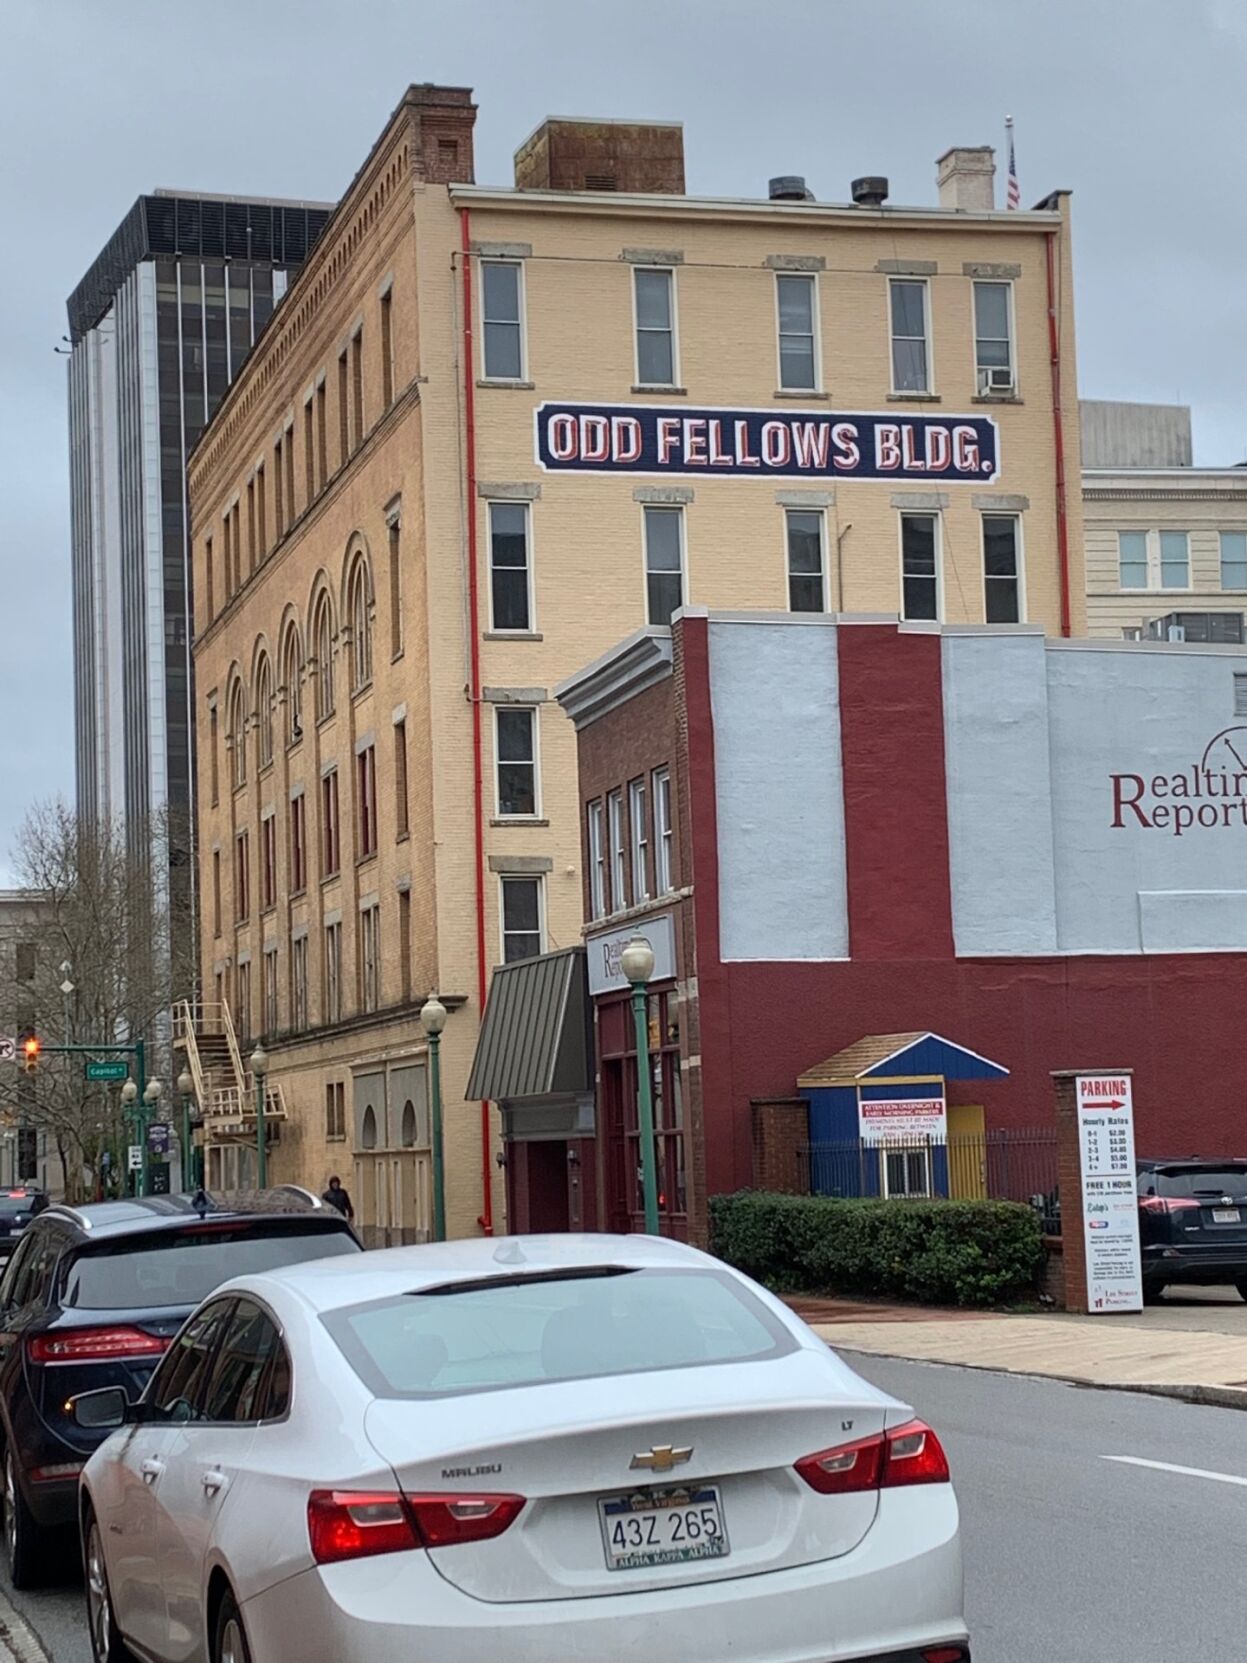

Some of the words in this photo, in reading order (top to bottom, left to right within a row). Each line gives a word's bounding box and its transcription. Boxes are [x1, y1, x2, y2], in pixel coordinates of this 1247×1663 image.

[548, 413, 642, 462] ODD
[656, 417, 860, 470] FELLOWS
[873, 423, 993, 473] BLDG.
[1081, 1080, 1126, 1096] PARKING
[1082, 1117, 1105, 1127] Hourly
[1107, 1116, 1129, 1125] Rates
[1087, 1138, 1098, 1146] 1-2
[1086, 1181, 1104, 1190] FREE
[1107, 1180, 1111, 1190] 1
[1112, 1180, 1132, 1189] HOUR
[841, 1420, 855, 1431] LT
[441, 1463, 502, 1479] MALIBU
[612, 1515, 661, 1549] 43Z
[668, 1508, 718, 1542] 265
[619, 1556, 650, 1568] ALPHA
